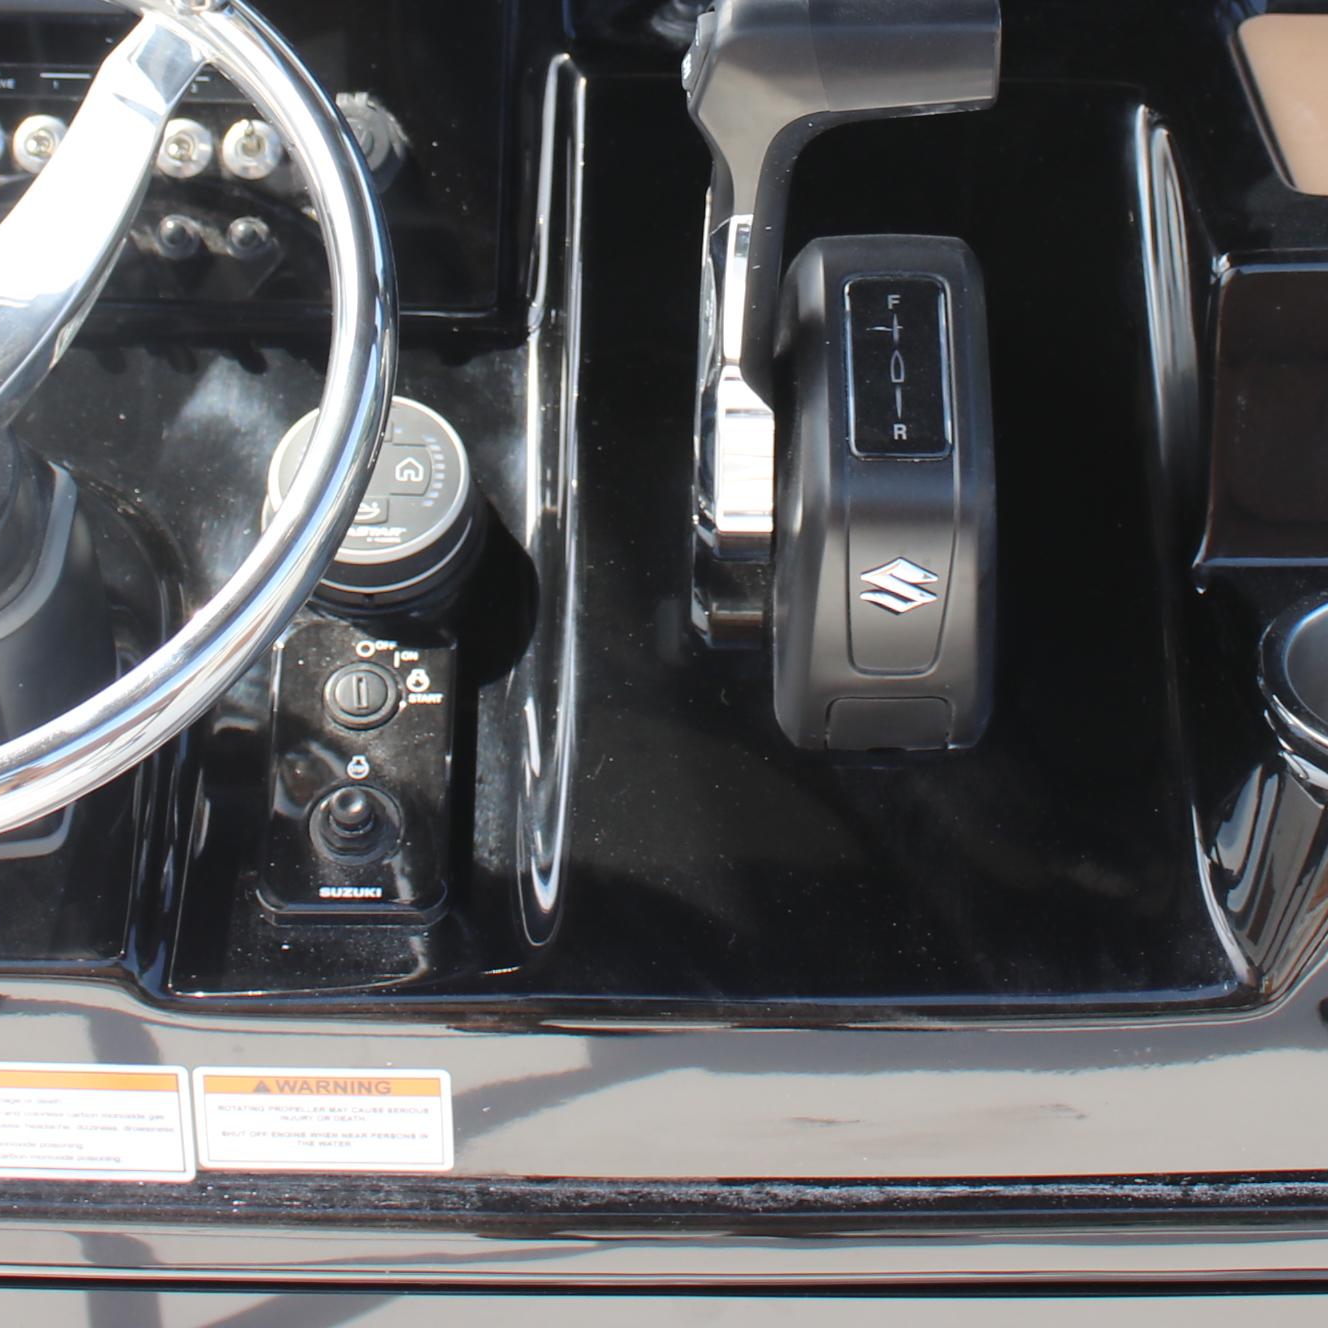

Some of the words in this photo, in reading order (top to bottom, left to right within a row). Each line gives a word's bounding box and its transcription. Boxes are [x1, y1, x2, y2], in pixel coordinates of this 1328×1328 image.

[887, 294, 901, 309] F
[893, 424, 907, 440] R
[375, 640, 398, 650] OFF
[400, 651, 419, 662] ON
[408, 693, 443, 704] START
[319, 887, 382, 898] SUZUKI
[275, 1079, 392, 1095] WARNING
